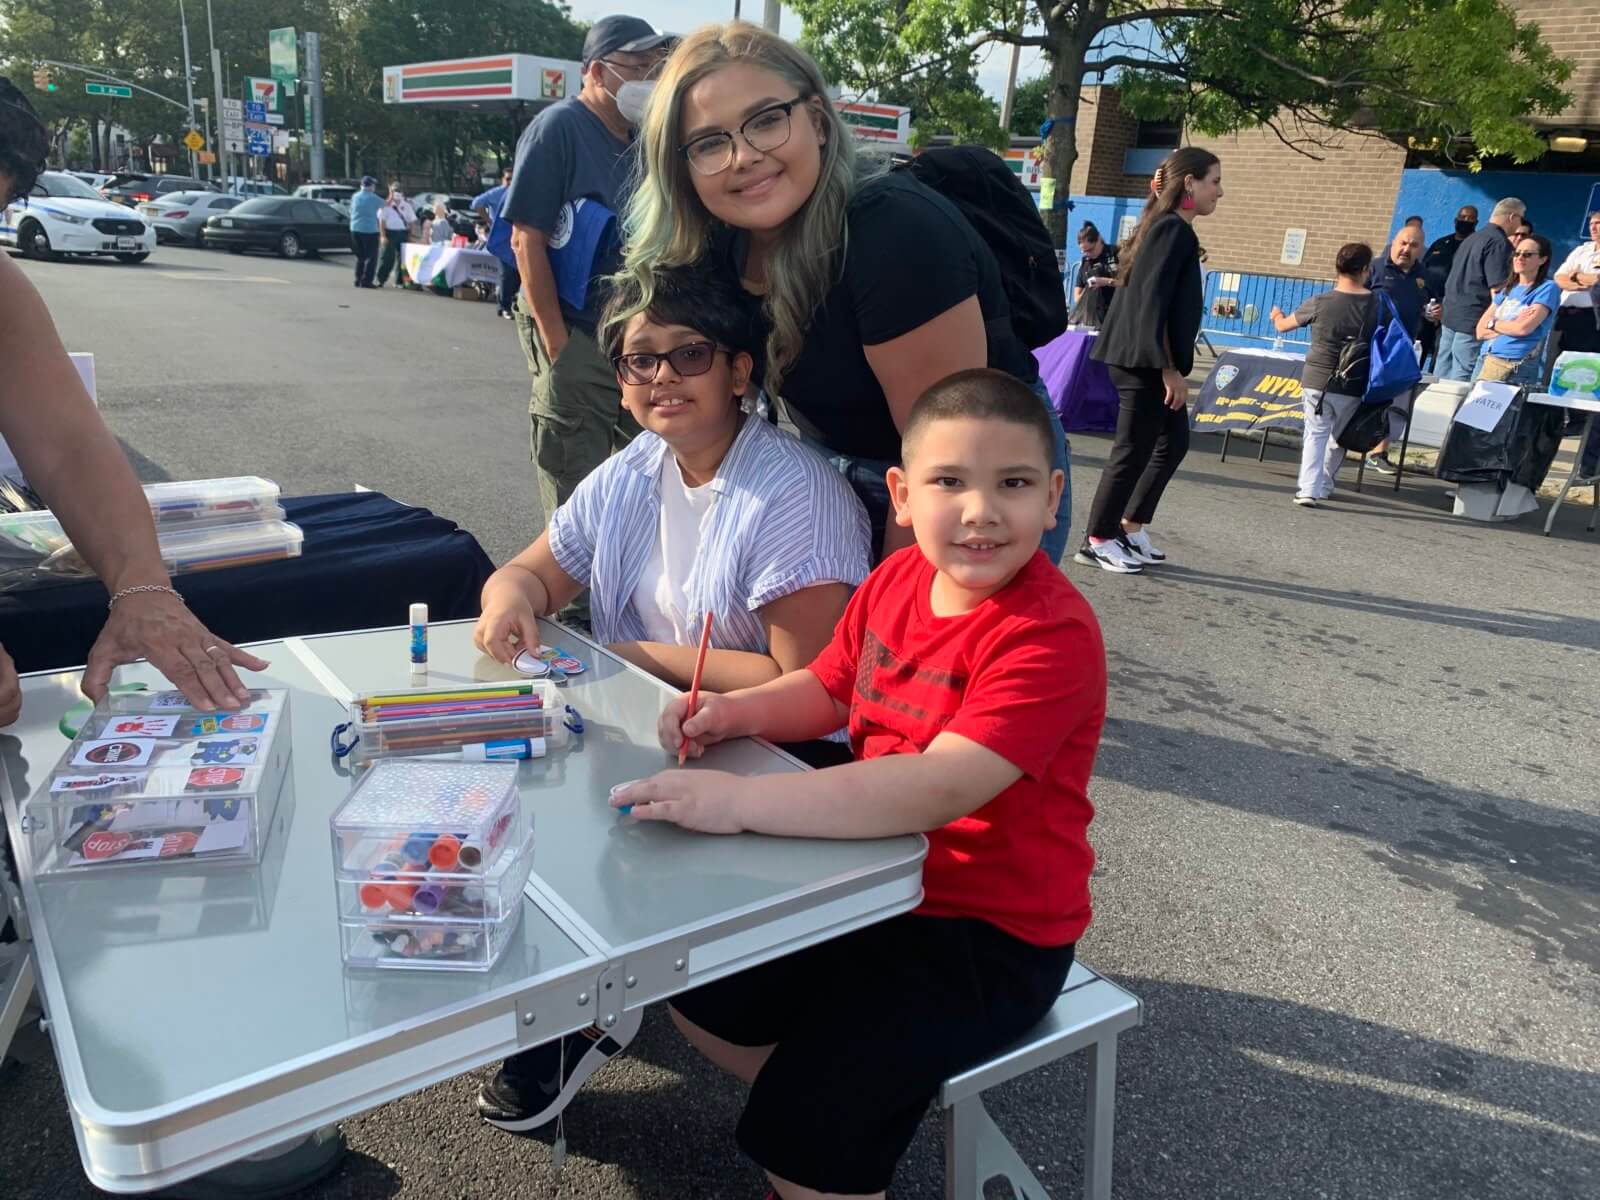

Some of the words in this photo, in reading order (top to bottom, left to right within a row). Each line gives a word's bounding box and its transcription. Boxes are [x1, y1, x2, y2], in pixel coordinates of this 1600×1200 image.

[103, 744, 122, 762] CRIME
[207, 768, 226, 784] STOP
[87, 838, 128, 852] STOP
